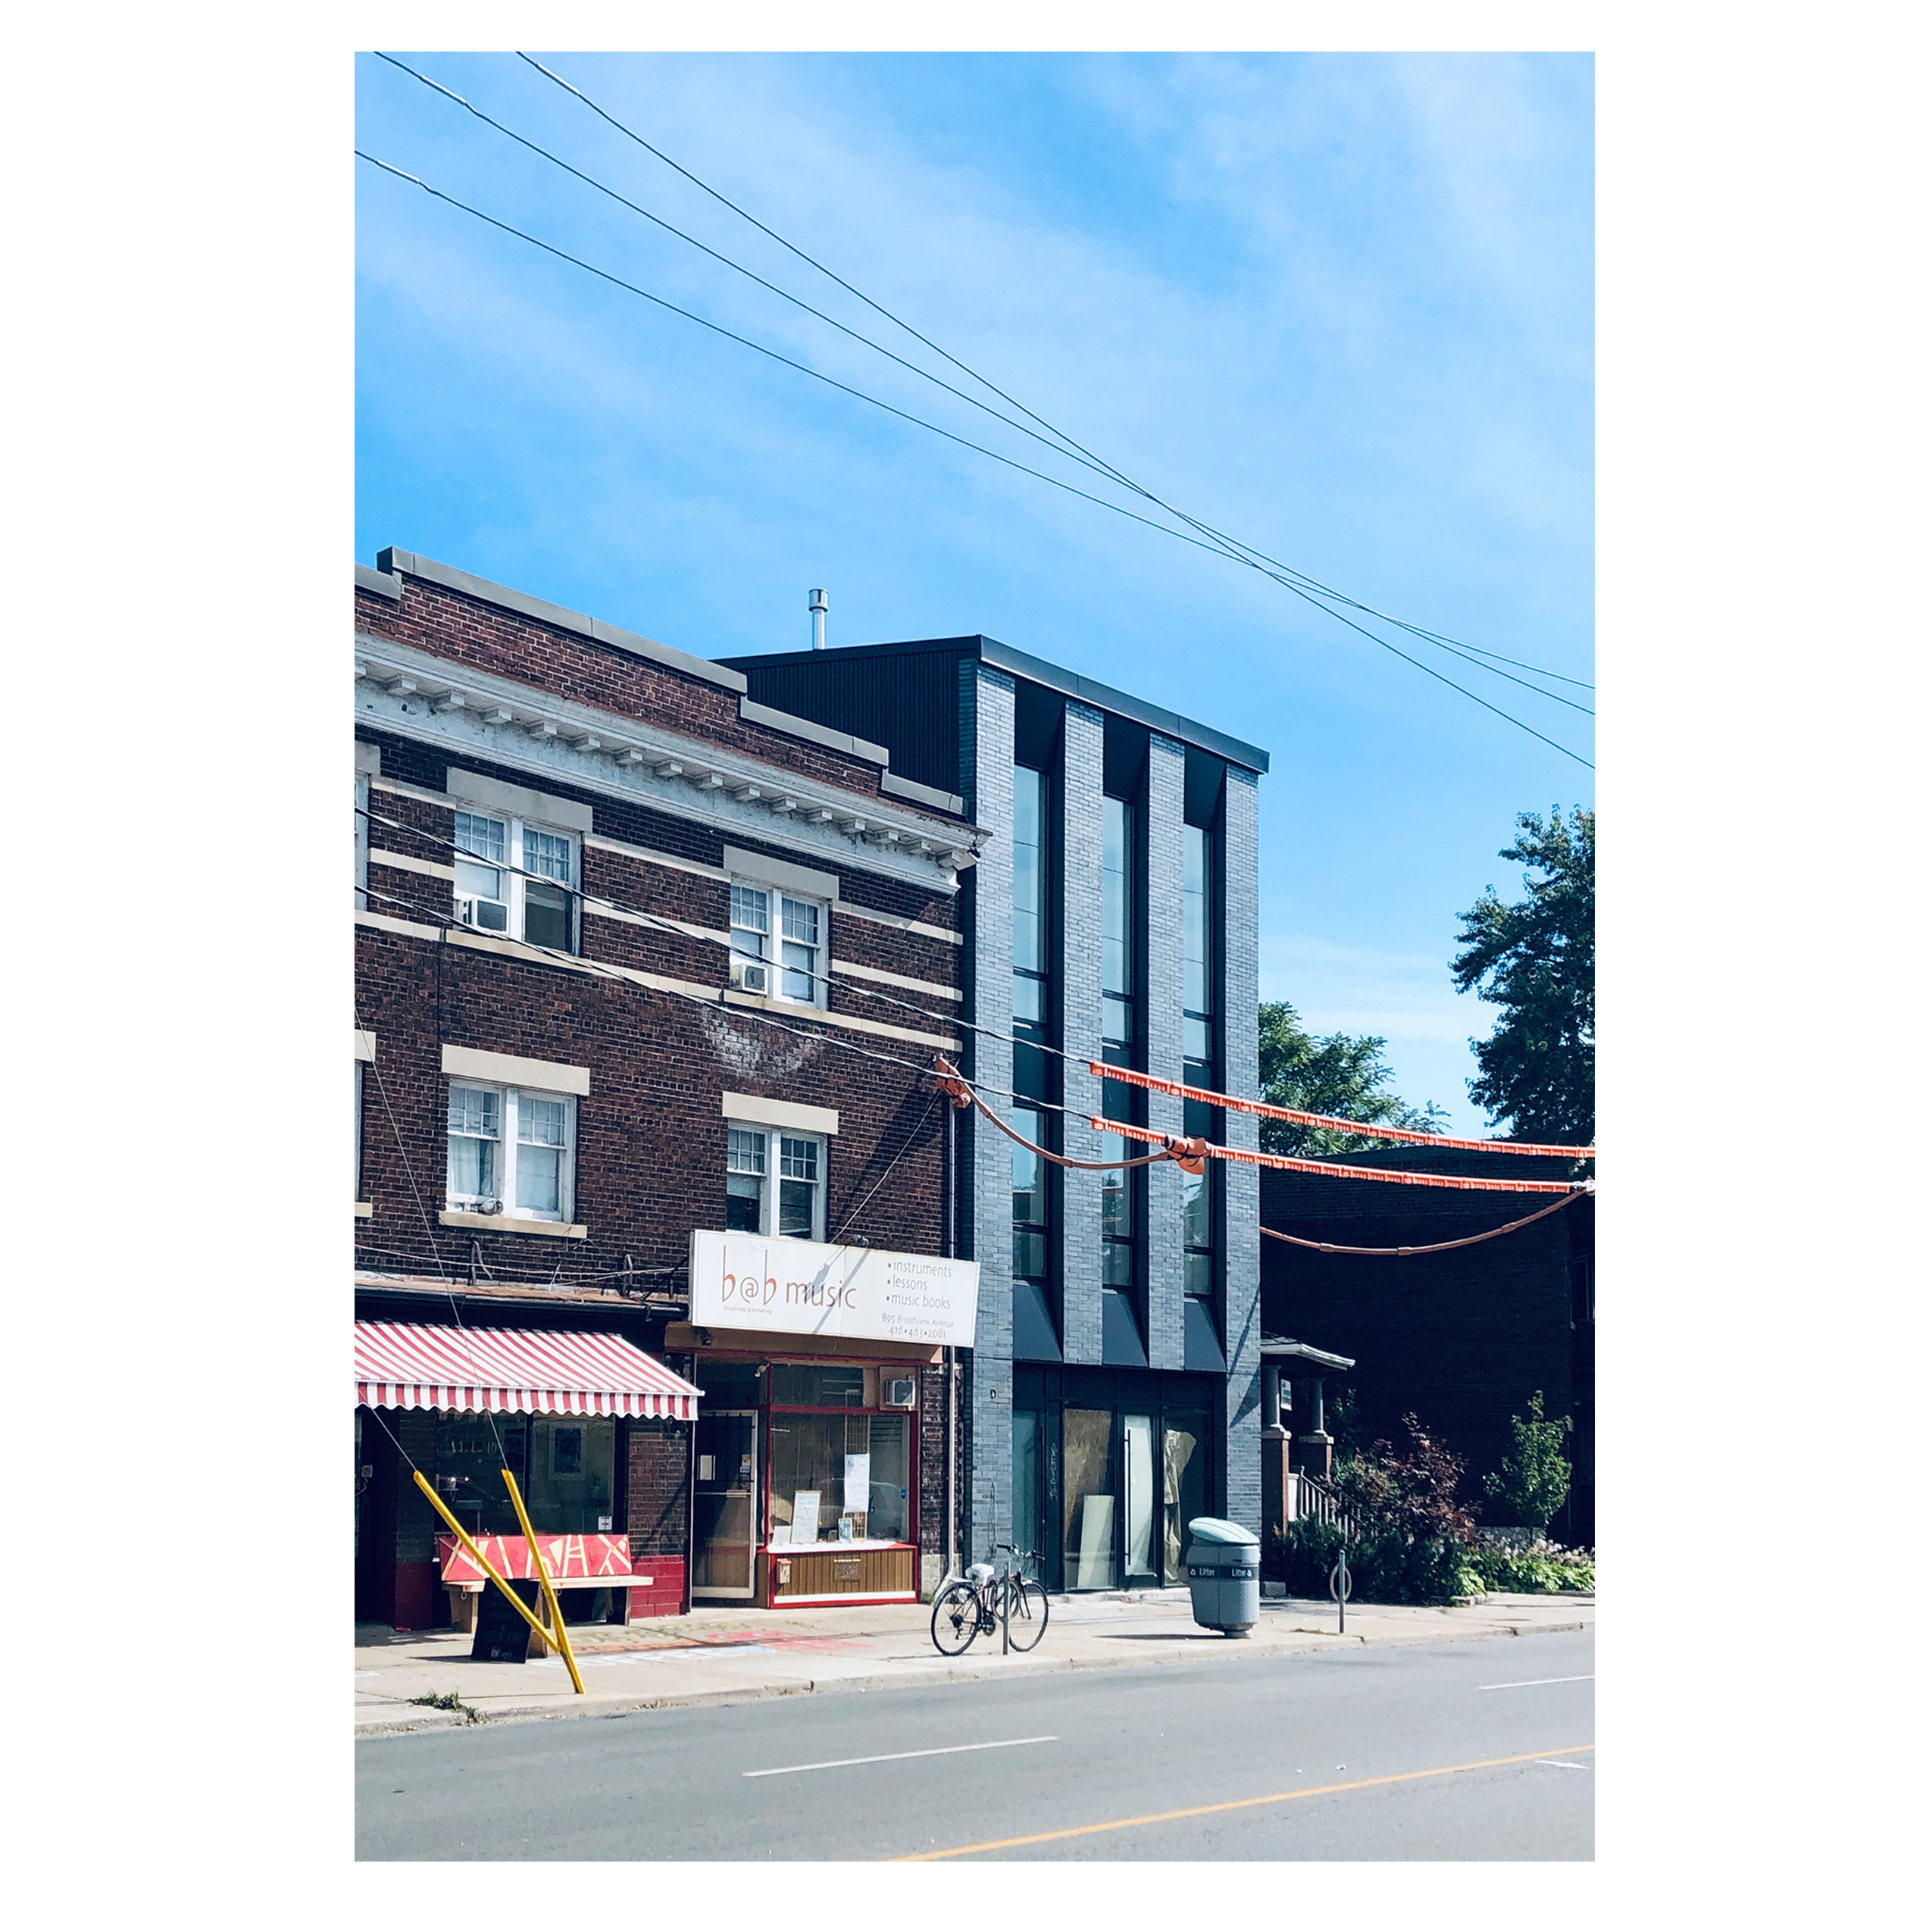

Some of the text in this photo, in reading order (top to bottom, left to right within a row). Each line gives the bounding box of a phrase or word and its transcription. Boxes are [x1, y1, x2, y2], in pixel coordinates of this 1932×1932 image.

[893, 1259, 952, 1277] instruments
[893, 1274, 927, 1290] lessons
[786, 1280, 857, 1309] music
[891, 1293, 951, 1309] music books
[881, 1312, 954, 1328] 895 Broadview Avenue
[1199, 1568, 1215, 1576] Litter
